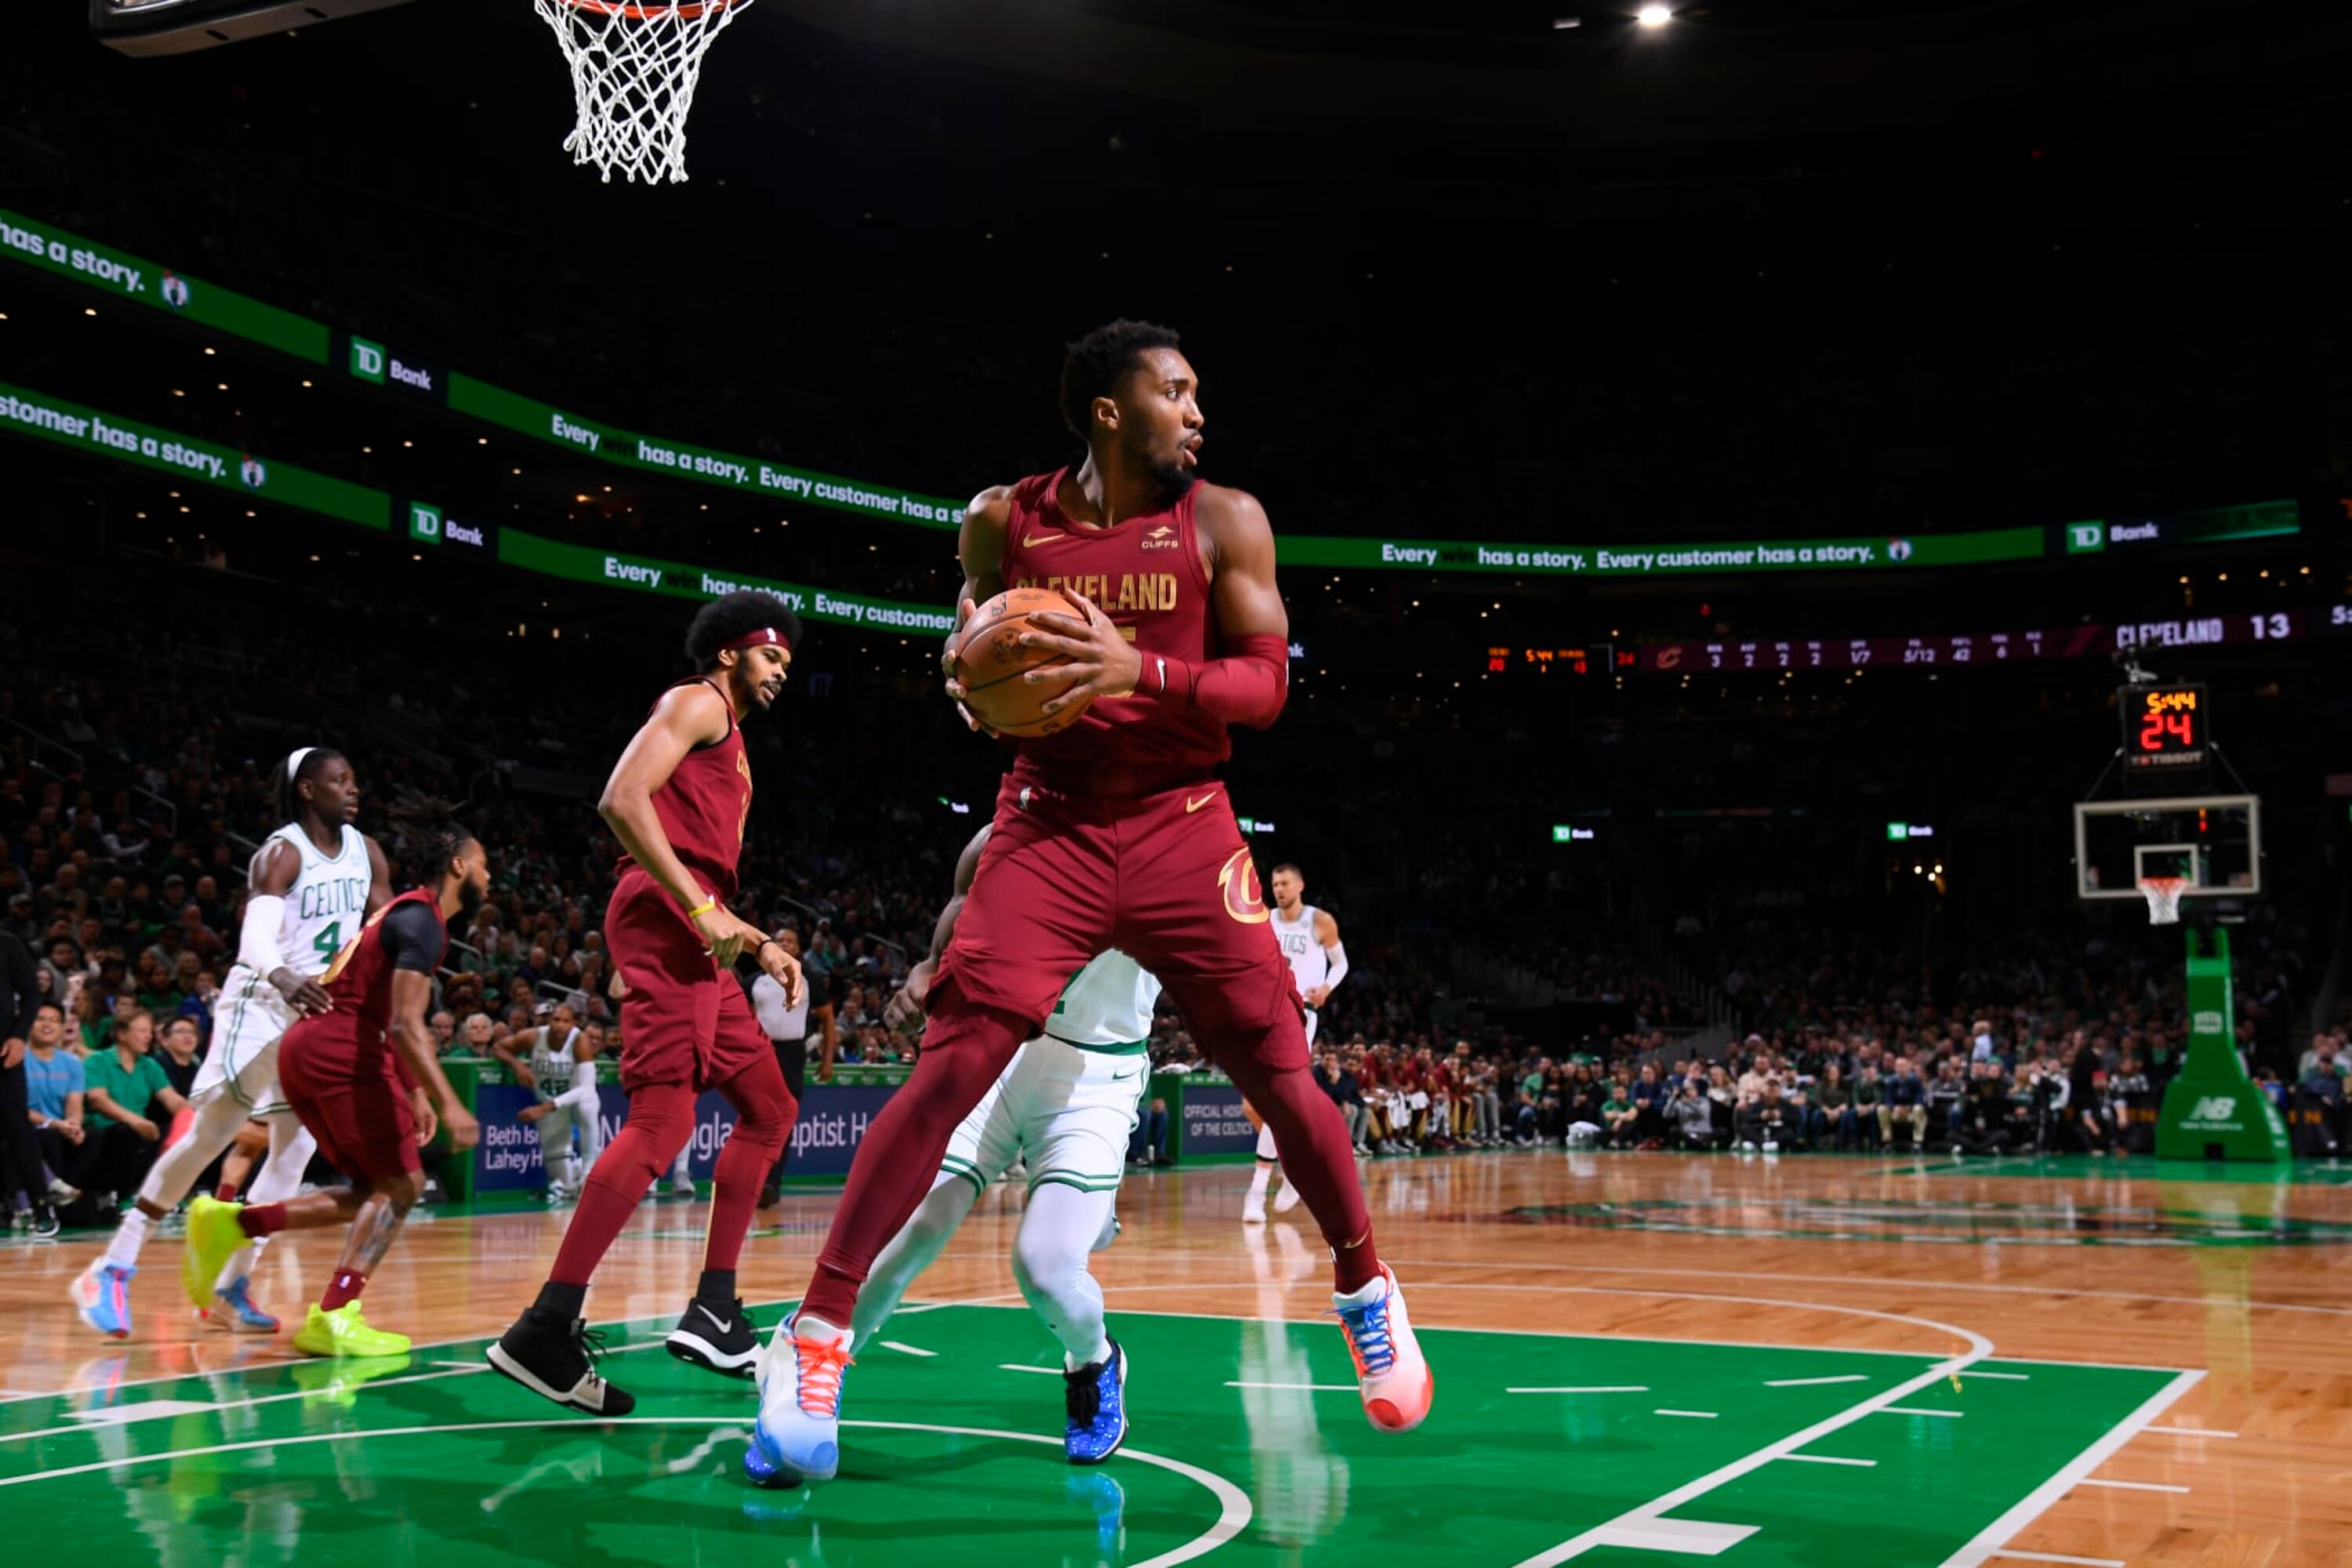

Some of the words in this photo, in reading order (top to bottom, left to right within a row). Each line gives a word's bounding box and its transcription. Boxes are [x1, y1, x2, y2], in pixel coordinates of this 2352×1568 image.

[49, 241, 67, 264] a
[71, 249, 145, 292] story.
[354, 343, 382, 374] TD
[390, 359, 431, 390] Bank
[92, 417, 138, 452] has
[142, 436, 158, 457] a
[162, 442, 226, 478] story.
[552, 414, 600, 452] Every
[638, 440, 675, 466] has
[678, 453, 691, 470] a
[695, 456, 749, 484] story.
[760, 466, 812, 498] Every
[815, 482, 899, 512] customer
[902, 497, 932, 519] has
[935, 507, 948, 521] a
[413, 508, 438, 535] TD
[445, 520, 483, 546] Bank
[2070, 526, 2101, 547] TD
[2111, 521, 2158, 542] Bank
[1142, 539, 1178, 550] CLIFFS
[1382, 544, 1437, 565] Every
[1478, 546, 1513, 565] has
[1516, 551, 1529, 566] a
[1532, 552, 1586, 571] story.
[1597, 551, 1653, 570] Every
[1657, 548, 1755, 567] customer
[1758, 546, 1795, 564] has
[1798, 547, 1813, 561] a
[1816, 546, 1875, 564] story.
[604, 557, 662, 587] Every
[815, 593, 864, 622] Every
[866, 606, 955, 630] customer
[2251, 613, 2291, 640] 13
[2147, 691, 2195, 714] 5:44
[2140, 713, 2192, 750] 24
[314, 920, 342, 964] 4
[1281, 933, 1307, 955] TICS
[487, 1124, 521, 1146] Beth
[791, 1112, 846, 1157] aptist
[485, 1148, 529, 1174] Lahey
